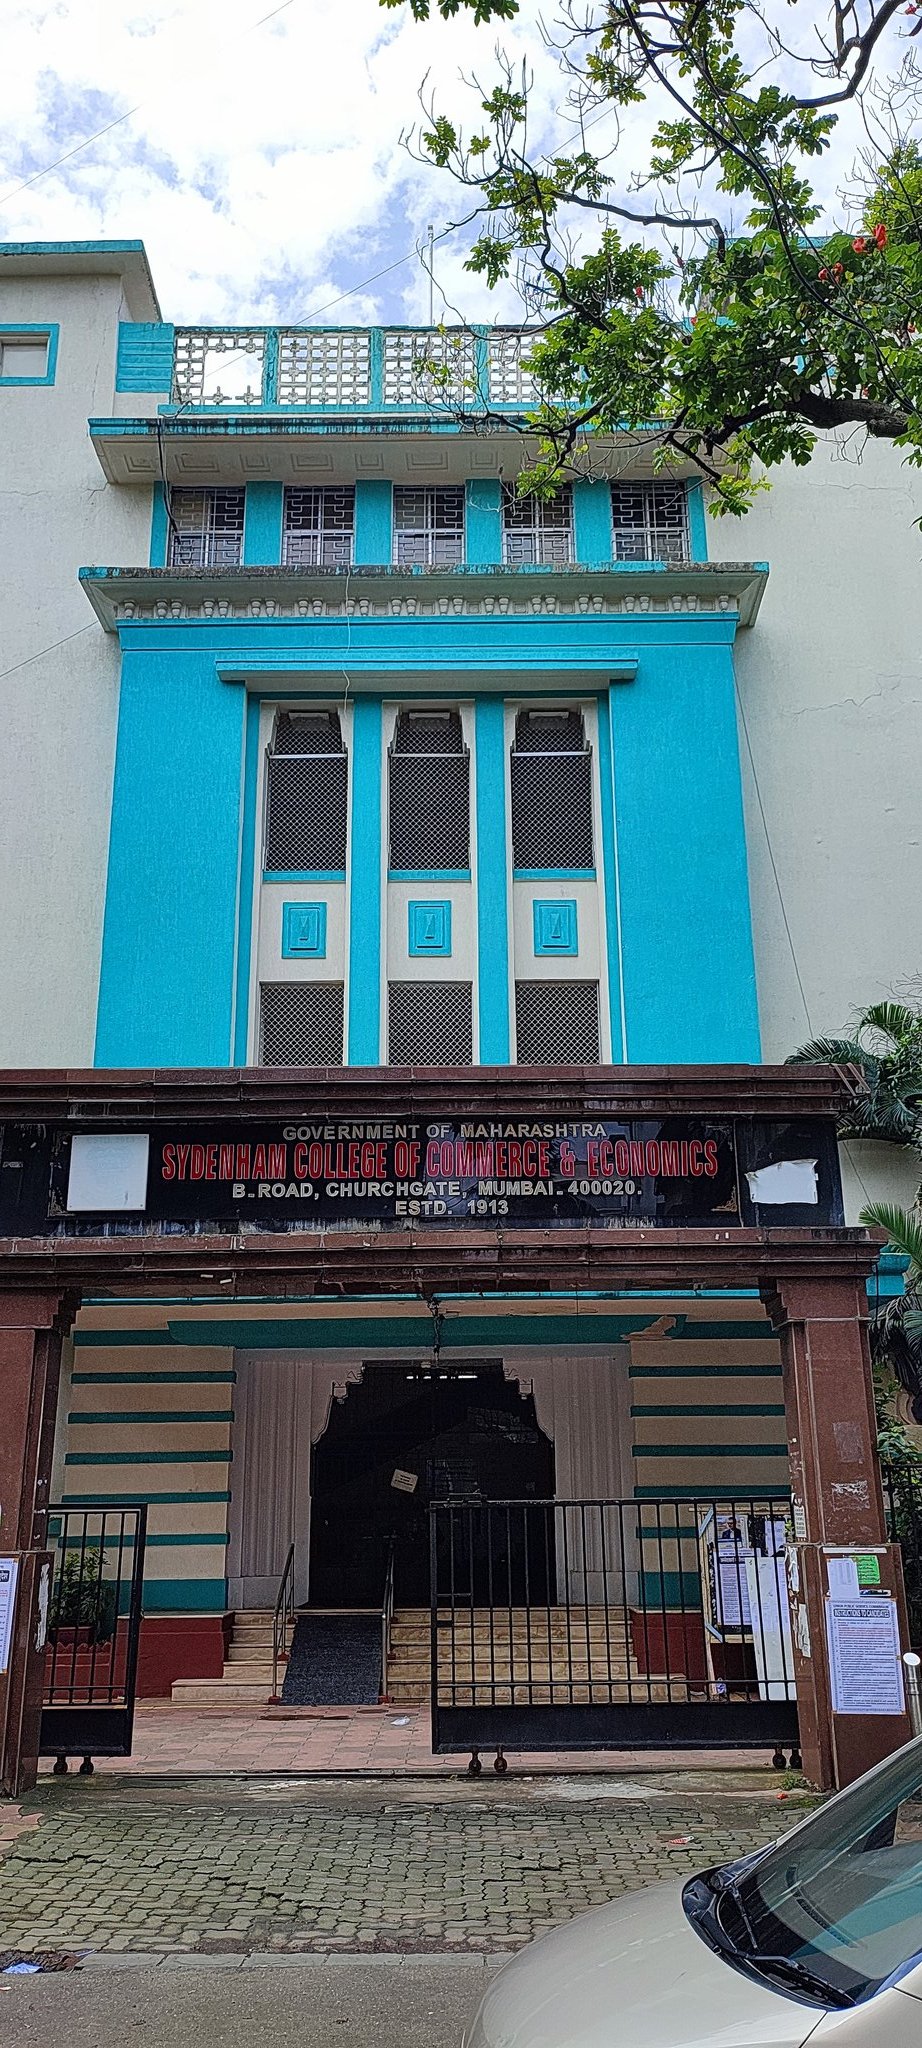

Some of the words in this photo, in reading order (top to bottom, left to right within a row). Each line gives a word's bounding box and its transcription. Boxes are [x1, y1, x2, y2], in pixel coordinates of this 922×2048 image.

[282, 1125, 419, 1141] GOVERNMENT
[426, 1124, 449, 1138] OF
[460, 1123, 607, 1138] MAHARASHTRA
[162, 1143, 287, 1180] SYDENHAM
[294, 1141, 387, 1179] COLLEGE
[394, 1141, 420, 1178] OF
[426, 1141, 550, 1177] COMMERCE
[560, 1141, 576, 1177] &
[587, 1139, 718, 1177] ECONOMICS
[326, 1181, 468, 1198] CHURCHGATE,
[395, 1200, 452, 1215] ESTD.
[467, 1199, 509, 1214] 1913
